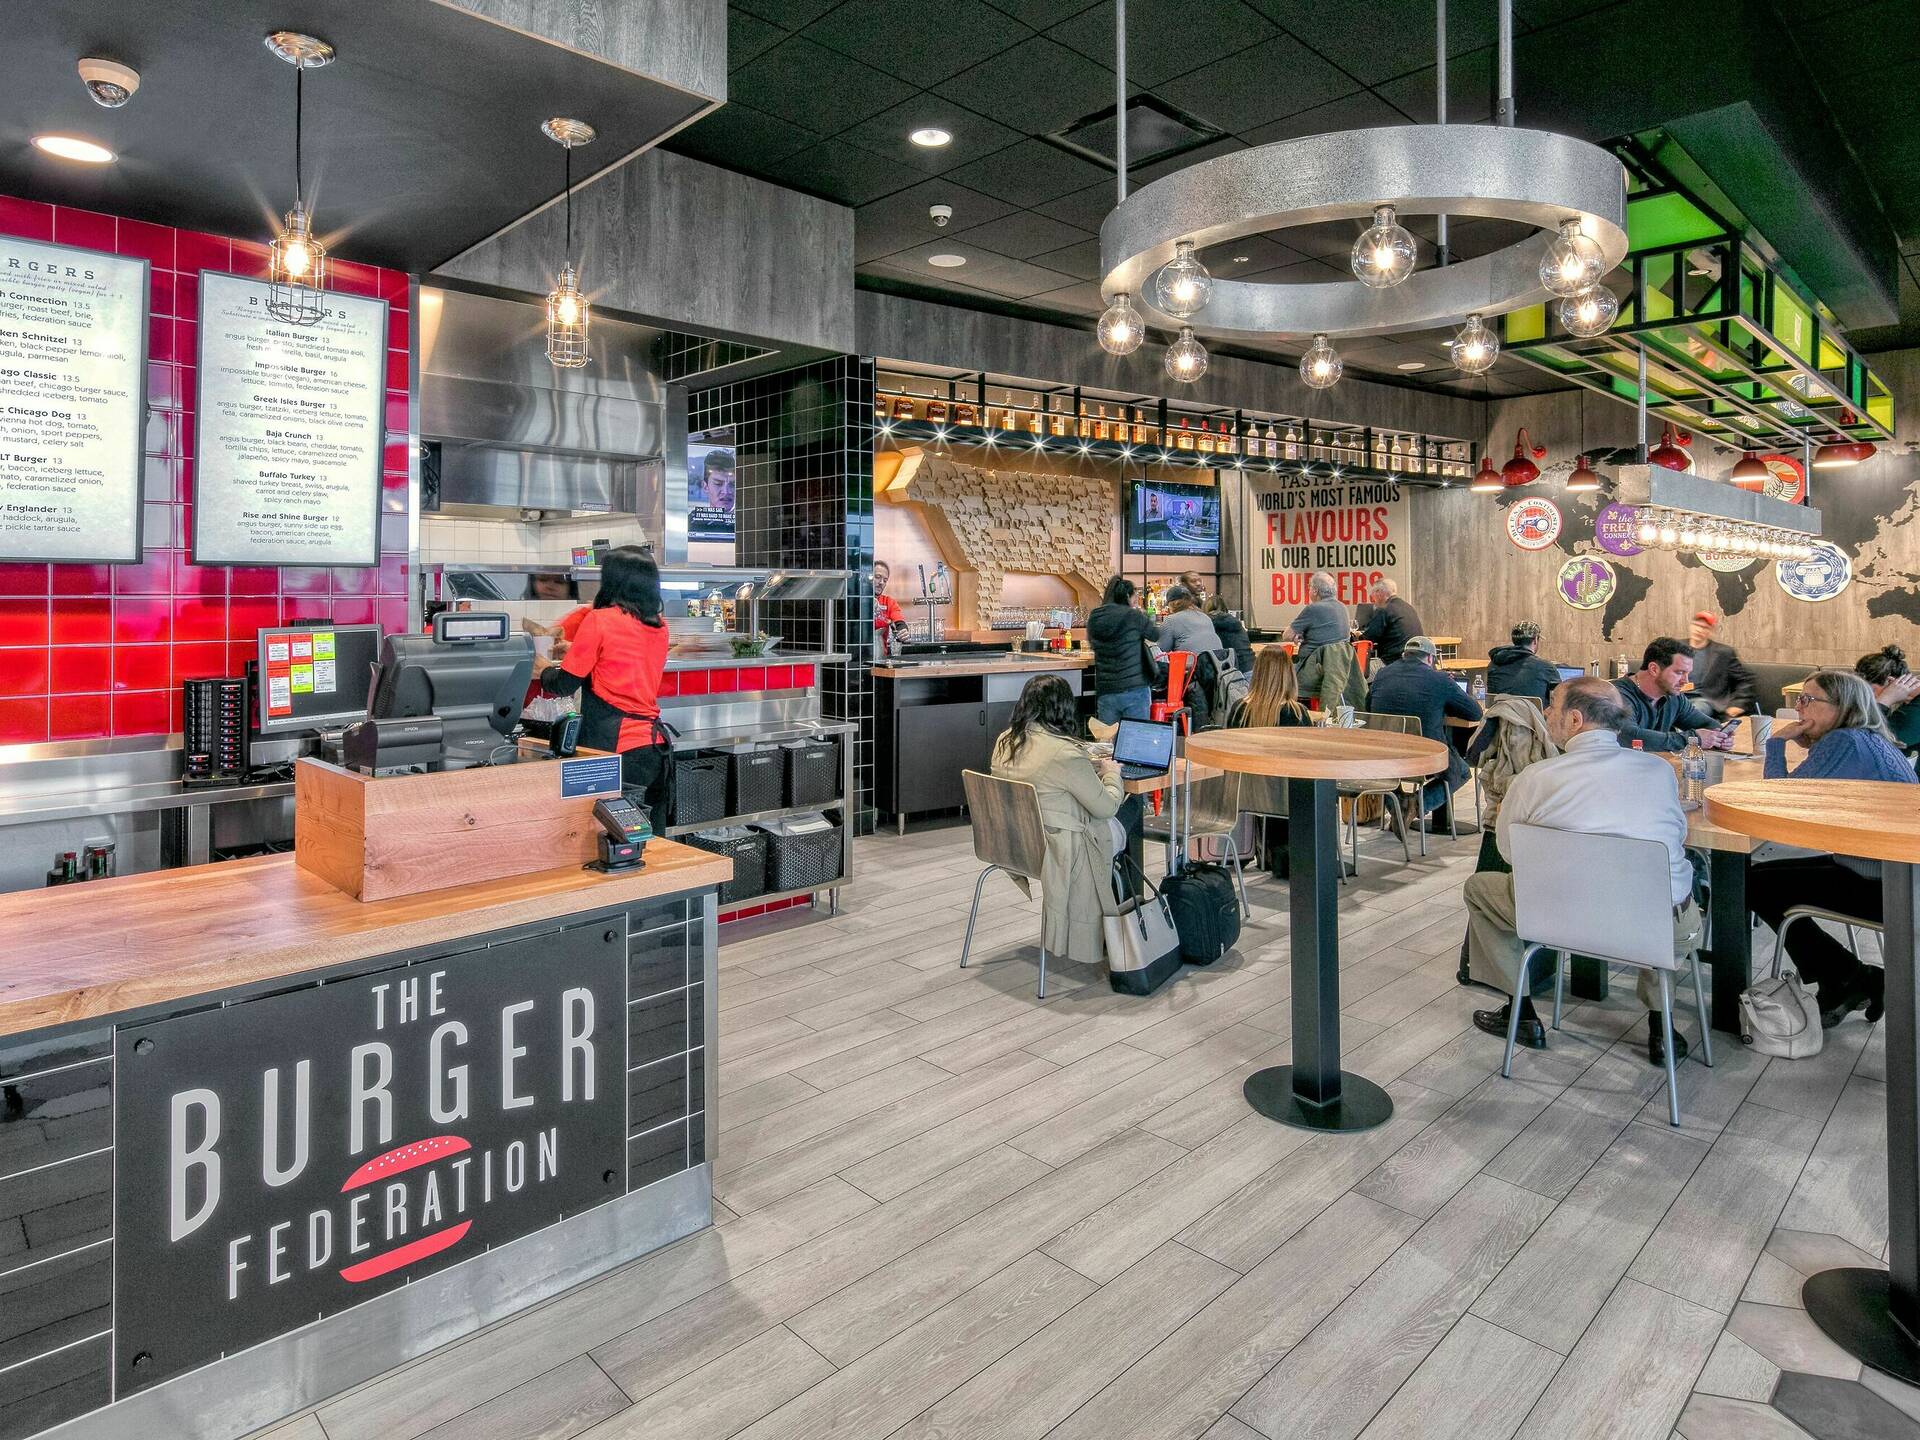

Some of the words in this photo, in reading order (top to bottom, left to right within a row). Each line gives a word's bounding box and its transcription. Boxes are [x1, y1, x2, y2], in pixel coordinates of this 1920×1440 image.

[10, 291, 67, 306] Connection
[73, 301, 90, 309] 13.5
[50, 308, 72, 318] beef,
[75, 311, 93, 320] brie,
[22, 313, 66, 325] federation
[68, 321, 92, 329] sauce
[22, 332, 67, 344] Schnitzel
[266, 329, 290, 338] Italian
[292, 332, 318, 342] Burger
[20, 342, 43, 351] black
[46, 346, 76, 355] pepper
[225, 332, 245, 341] angus
[296, 342, 325, 351] sundried
[326, 345, 350, 354] tomato
[28, 353, 68, 363] parmesan
[247, 343, 263, 351] fresh
[305, 351, 322, 360] basil,
[323, 354, 347, 362] arugula
[24, 370, 57, 381] Classic
[63, 375, 80, 383] 13.5
[301, 367, 326, 376] Burger
[220, 367, 259, 377] impossible
[313, 377, 342, 386] american
[344, 381, 368, 390] cheese,
[241, 377, 267, 386] lettuce,
[269, 381, 295, 389] tomato,
[296, 383, 330, 392] federation
[14, 380, 36, 389] beef,
[39, 382, 72, 392] chicago
[75, 386, 101, 395] burger
[103, 389, 128, 398] sauce,
[42, 392, 76, 402] iceberg,
[79, 396, 108, 404] tomato
[253, 395, 278, 404] Greek
[280, 398, 298, 406] Isles
[300, 399, 326, 409] Burger
[8, 406, 48, 418] Chicago
[51, 411, 71, 420] Dog
[216, 401, 237, 409] angus
[239, 402, 263, 411] burger,
[293, 408, 318, 417] iceberg
[319, 410, 343, 419] lettuce,
[28, 418, 43, 426] hot
[45, 420, 65, 429] dog,
[67, 421, 99, 431] tomato,
[222, 409, 238, 417] feta,
[240, 410, 281, 420] caramelized
[283, 415, 307, 424] onions,
[309, 417, 326, 425] black
[328, 419, 343, 427] olive
[11, 427, 38, 436] onion,
[41, 429, 63, 437] sport
[65, 431, 103, 441] peppers,
[266, 430, 282, 439] Baja
[284, 431, 312, 440] Crunch
[3, 436, 40, 446] mustard,
[42, 438, 68, 448] celery
[70, 440, 84, 448] salt
[219, 435, 240, 444] angus
[242, 437, 266, 445] burger,
[267, 438, 286, 446] black
[287, 440, 309, 449] beans,
[310, 442, 338, 451] cheddar,
[249, 445, 270, 454] chips,
[271, 447, 297, 455] lettuce,
[298, 449, 338, 458] caramelized
[14, 454, 48, 464] Burger
[53, 457, 63, 465] 13
[271, 455, 290, 464] spicy
[312, 458, 347, 466] guacamole
[8, 464, 38, 473] bacon,
[40, 466, 73, 476] iceberg
[75, 467, 105, 477] lettuce,
[259, 471, 288, 479] Buffalo
[290, 473, 315, 481] Turkey
[25, 475, 76, 484] caramelized
[233, 478, 257, 486] shaved
[259, 480, 280, 488] turkey
[281, 481, 303, 489] breast,
[7, 482, 50, 491] federation
[52, 485, 76, 493] sauce
[291, 490, 311, 498] celery
[263, 496, 282, 504] spicy
[1256, 491, 1306, 511] WORLD'S
[1311, 487, 1344, 508] MOST
[1350, 484, 1400, 505] FAMOUS
[7, 504, 57, 513] Englander
[3, 514, 43, 523] haddock,
[46, 516, 78, 525] arugula,
[242, 511, 259, 519] Rise
[303, 514, 328, 522] Burger
[1618, 513, 1633, 523] the
[6, 524, 31, 532] pickle
[34, 524, 55, 532] tartar
[259, 521, 282, 529] burger,
[284, 522, 303, 530] sunny
[1267, 507, 1389, 545] FLAVOURS
[250, 529, 273, 537] bacon,
[1261, 548, 1275, 569] IN
[1282, 546, 1310, 569] OUR
[1317, 543, 1397, 569] DELICIOUS
[372, 971, 446, 1030] THE
[171, 987, 595, 1243] BURGER
[229, 1128, 558, 1300] FEDERATION
